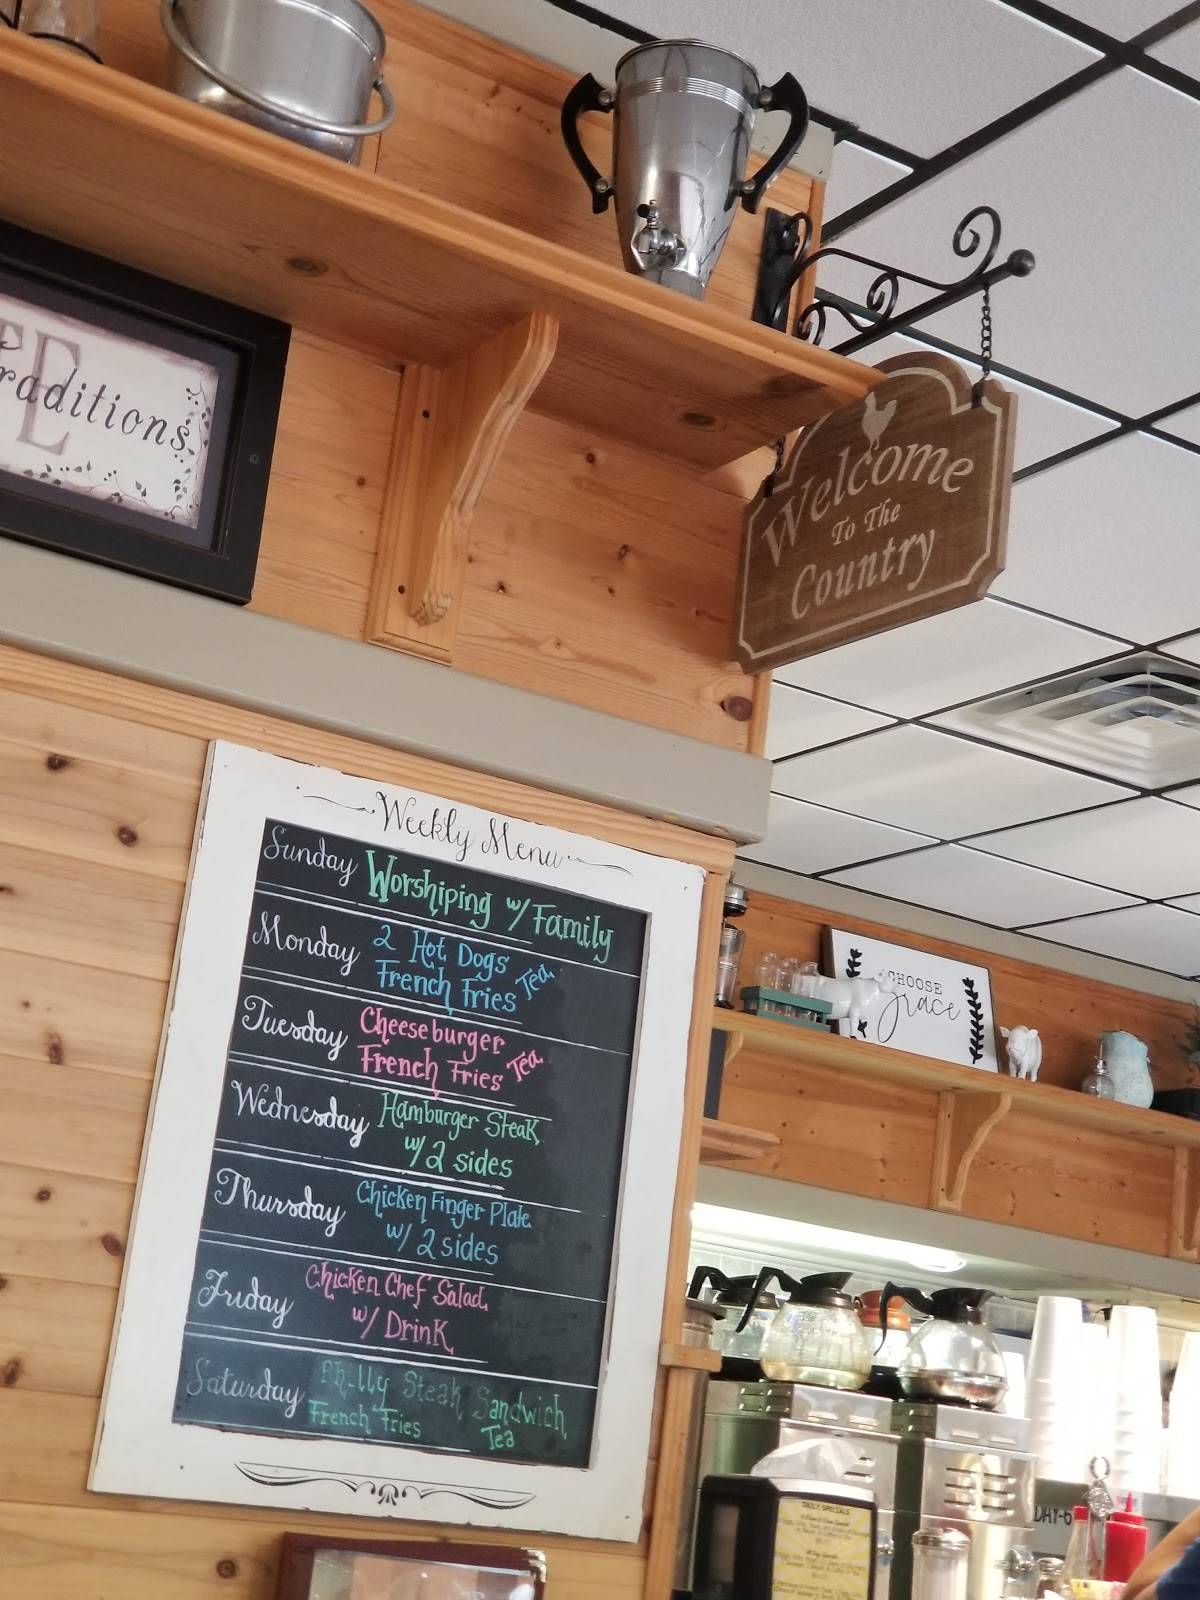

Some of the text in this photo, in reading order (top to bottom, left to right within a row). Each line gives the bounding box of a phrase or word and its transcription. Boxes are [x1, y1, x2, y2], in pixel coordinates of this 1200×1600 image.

[0, 366, 191, 452] raditions
[762, 442, 974, 567] Welcome
[832, 498, 901, 545] To The
[791, 529, 936, 620] Country
[263, 825, 359, 887] Sunday
[375, 791, 566, 869] Weekly Menu
[366, 850, 615, 964] Worshiping w/ Family
[252, 911, 361, 976] Monday
[373, 924, 510, 982] 2 Hot Dogs
[375, 959, 517, 1016] French Fries
[515, 963, 556, 1001] Tea
[887, 970, 943, 995] CHOOSE
[241, 994, 348, 1060] Tuesday
[360, 1006, 506, 1063] Cheeseburger
[357, 1044, 504, 1100] French Fries
[506, 1049, 544, 1083] Tea
[231, 1080, 370, 1148] Wednesday
[377, 1092, 480, 1141] Hamburger
[404, 1135, 513, 1178] w/ 2 sides
[213, 1167, 346, 1237] Thursday
[431, 1191, 485, 1229] Finger
[489, 1201, 532, 1229] Plate
[386, 1223, 499, 1265] w/ 2 sides
[197, 1269, 294, 1329] Friday
[385, 1271, 431, 1310] Chef
[432, 1278, 488, 1312] Salad
[352, 1306, 380, 1339] w/
[186, 1357, 306, 1419] Saturday
[320, 1359, 391, 1411] Philly
[472, 1385, 568, 1440] Sandwich
[308, 1400, 422, 1439] French Fries
[480, 1424, 515, 1450] Tea
